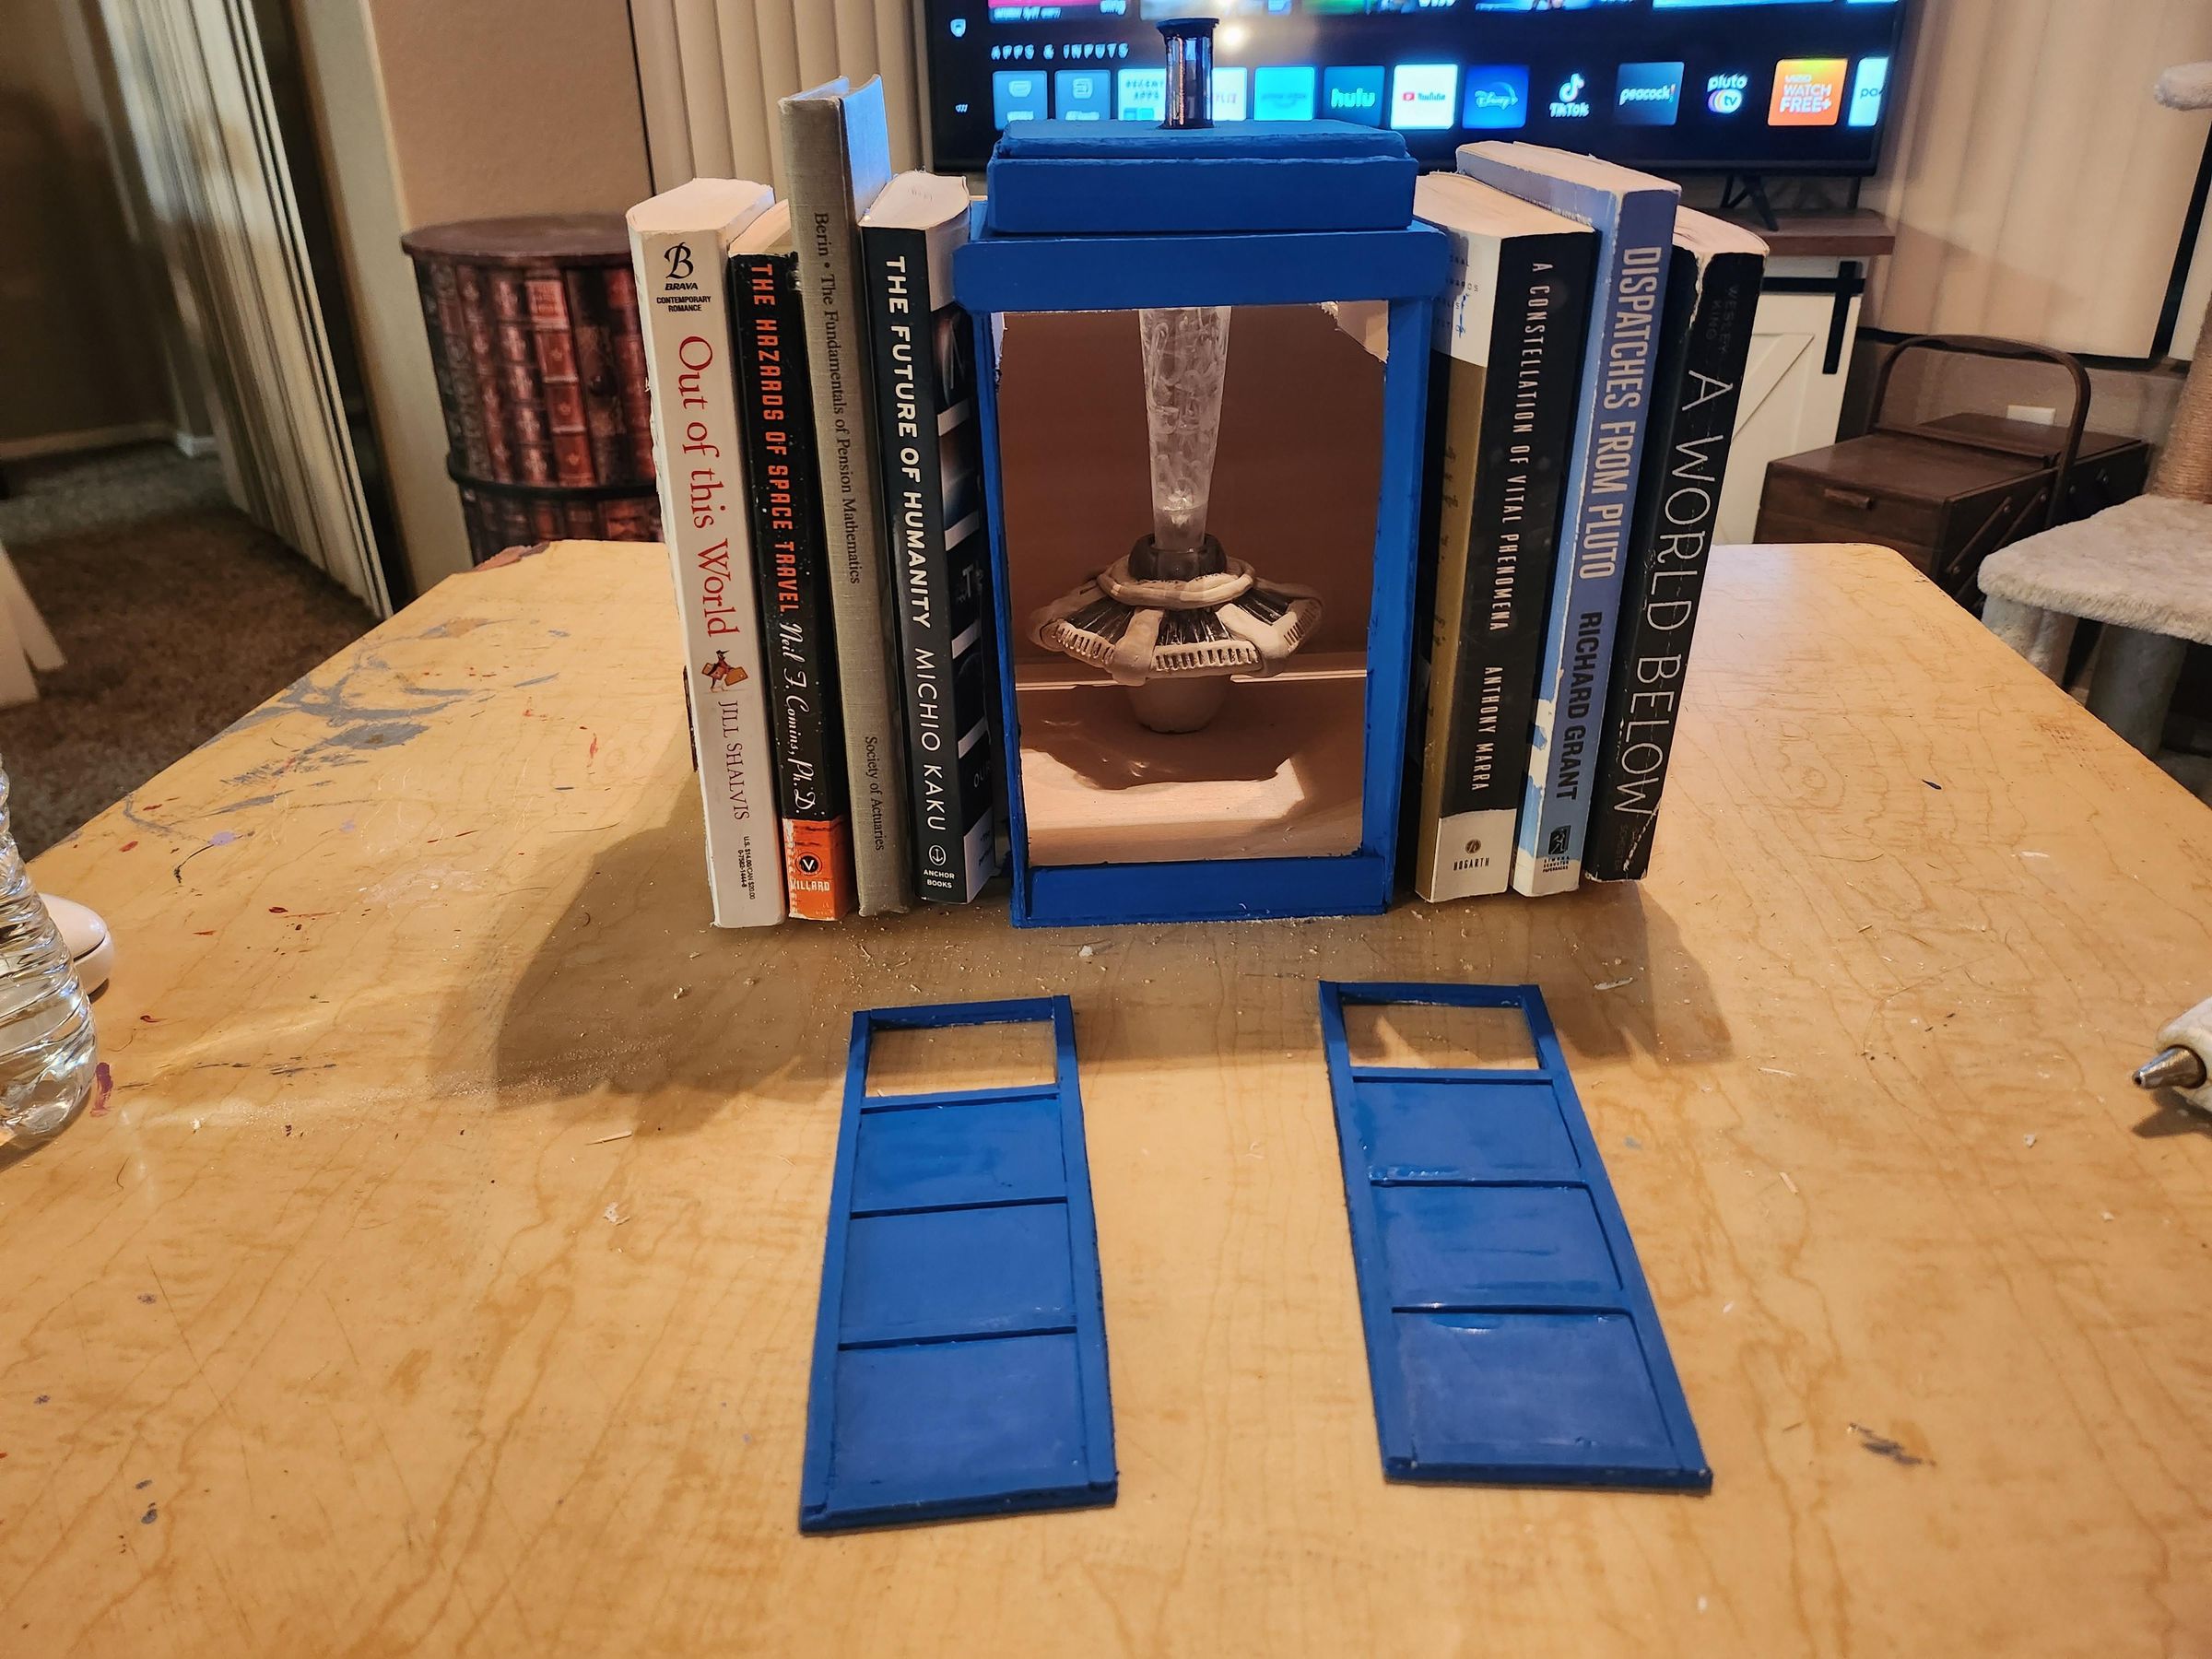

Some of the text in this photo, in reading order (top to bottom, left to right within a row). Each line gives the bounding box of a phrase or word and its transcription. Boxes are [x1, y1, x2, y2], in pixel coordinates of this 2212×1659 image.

[991, 44, 1034, 60] APPS
[1063, 42, 1129, 59] INPUTS
[1708, 72, 1747, 92] pluto
[1783, 83, 1832, 97] WATCH
[1331, 88, 1375, 108] hulu
[1724, 94, 1737, 107] tv
[1779, 97, 1832, 112] FREE+
[1549, 101, 1589, 117] TikTok
[665, 282, 699, 291] BRAVA
[656, 295, 712, 305] CONTEMPORARY
[668, 303, 702, 312] ROMANCE
[814, 211, 863, 584] Berin The Fundamentals of Pension Mathematics
[750, 264, 800, 614] THE HAZARDS OF SPACE TRAVEL
[677, 335, 741, 638] Out of this World
[1471, 262, 1554, 791] A CONSTELLATION OF VITAL PHENOMENA ANTHONY MARRA
[1555, 246, 1663, 801] DISPATCHES FROM PLUTO RICHARD GRANT
[884, 255, 947, 831] THE FUTURE OF HUMANITY MICHIO KAKU
[1612, 369, 1734, 817] A WORLD BELOW
[779, 622, 806, 663] Neil
[785, 695, 811, 756] Comins,
[717, 699, 751, 821] JILL SHALVIS
[865, 736, 886, 852] Society of Actuaries
[802, 858, 815, 871] V
[1453, 857, 1489, 871] HOGARTH
[924, 869, 955, 879] ANCHOR
[926, 879, 953, 888] BOOKS
[790, 877, 830, 892] VILLARD
